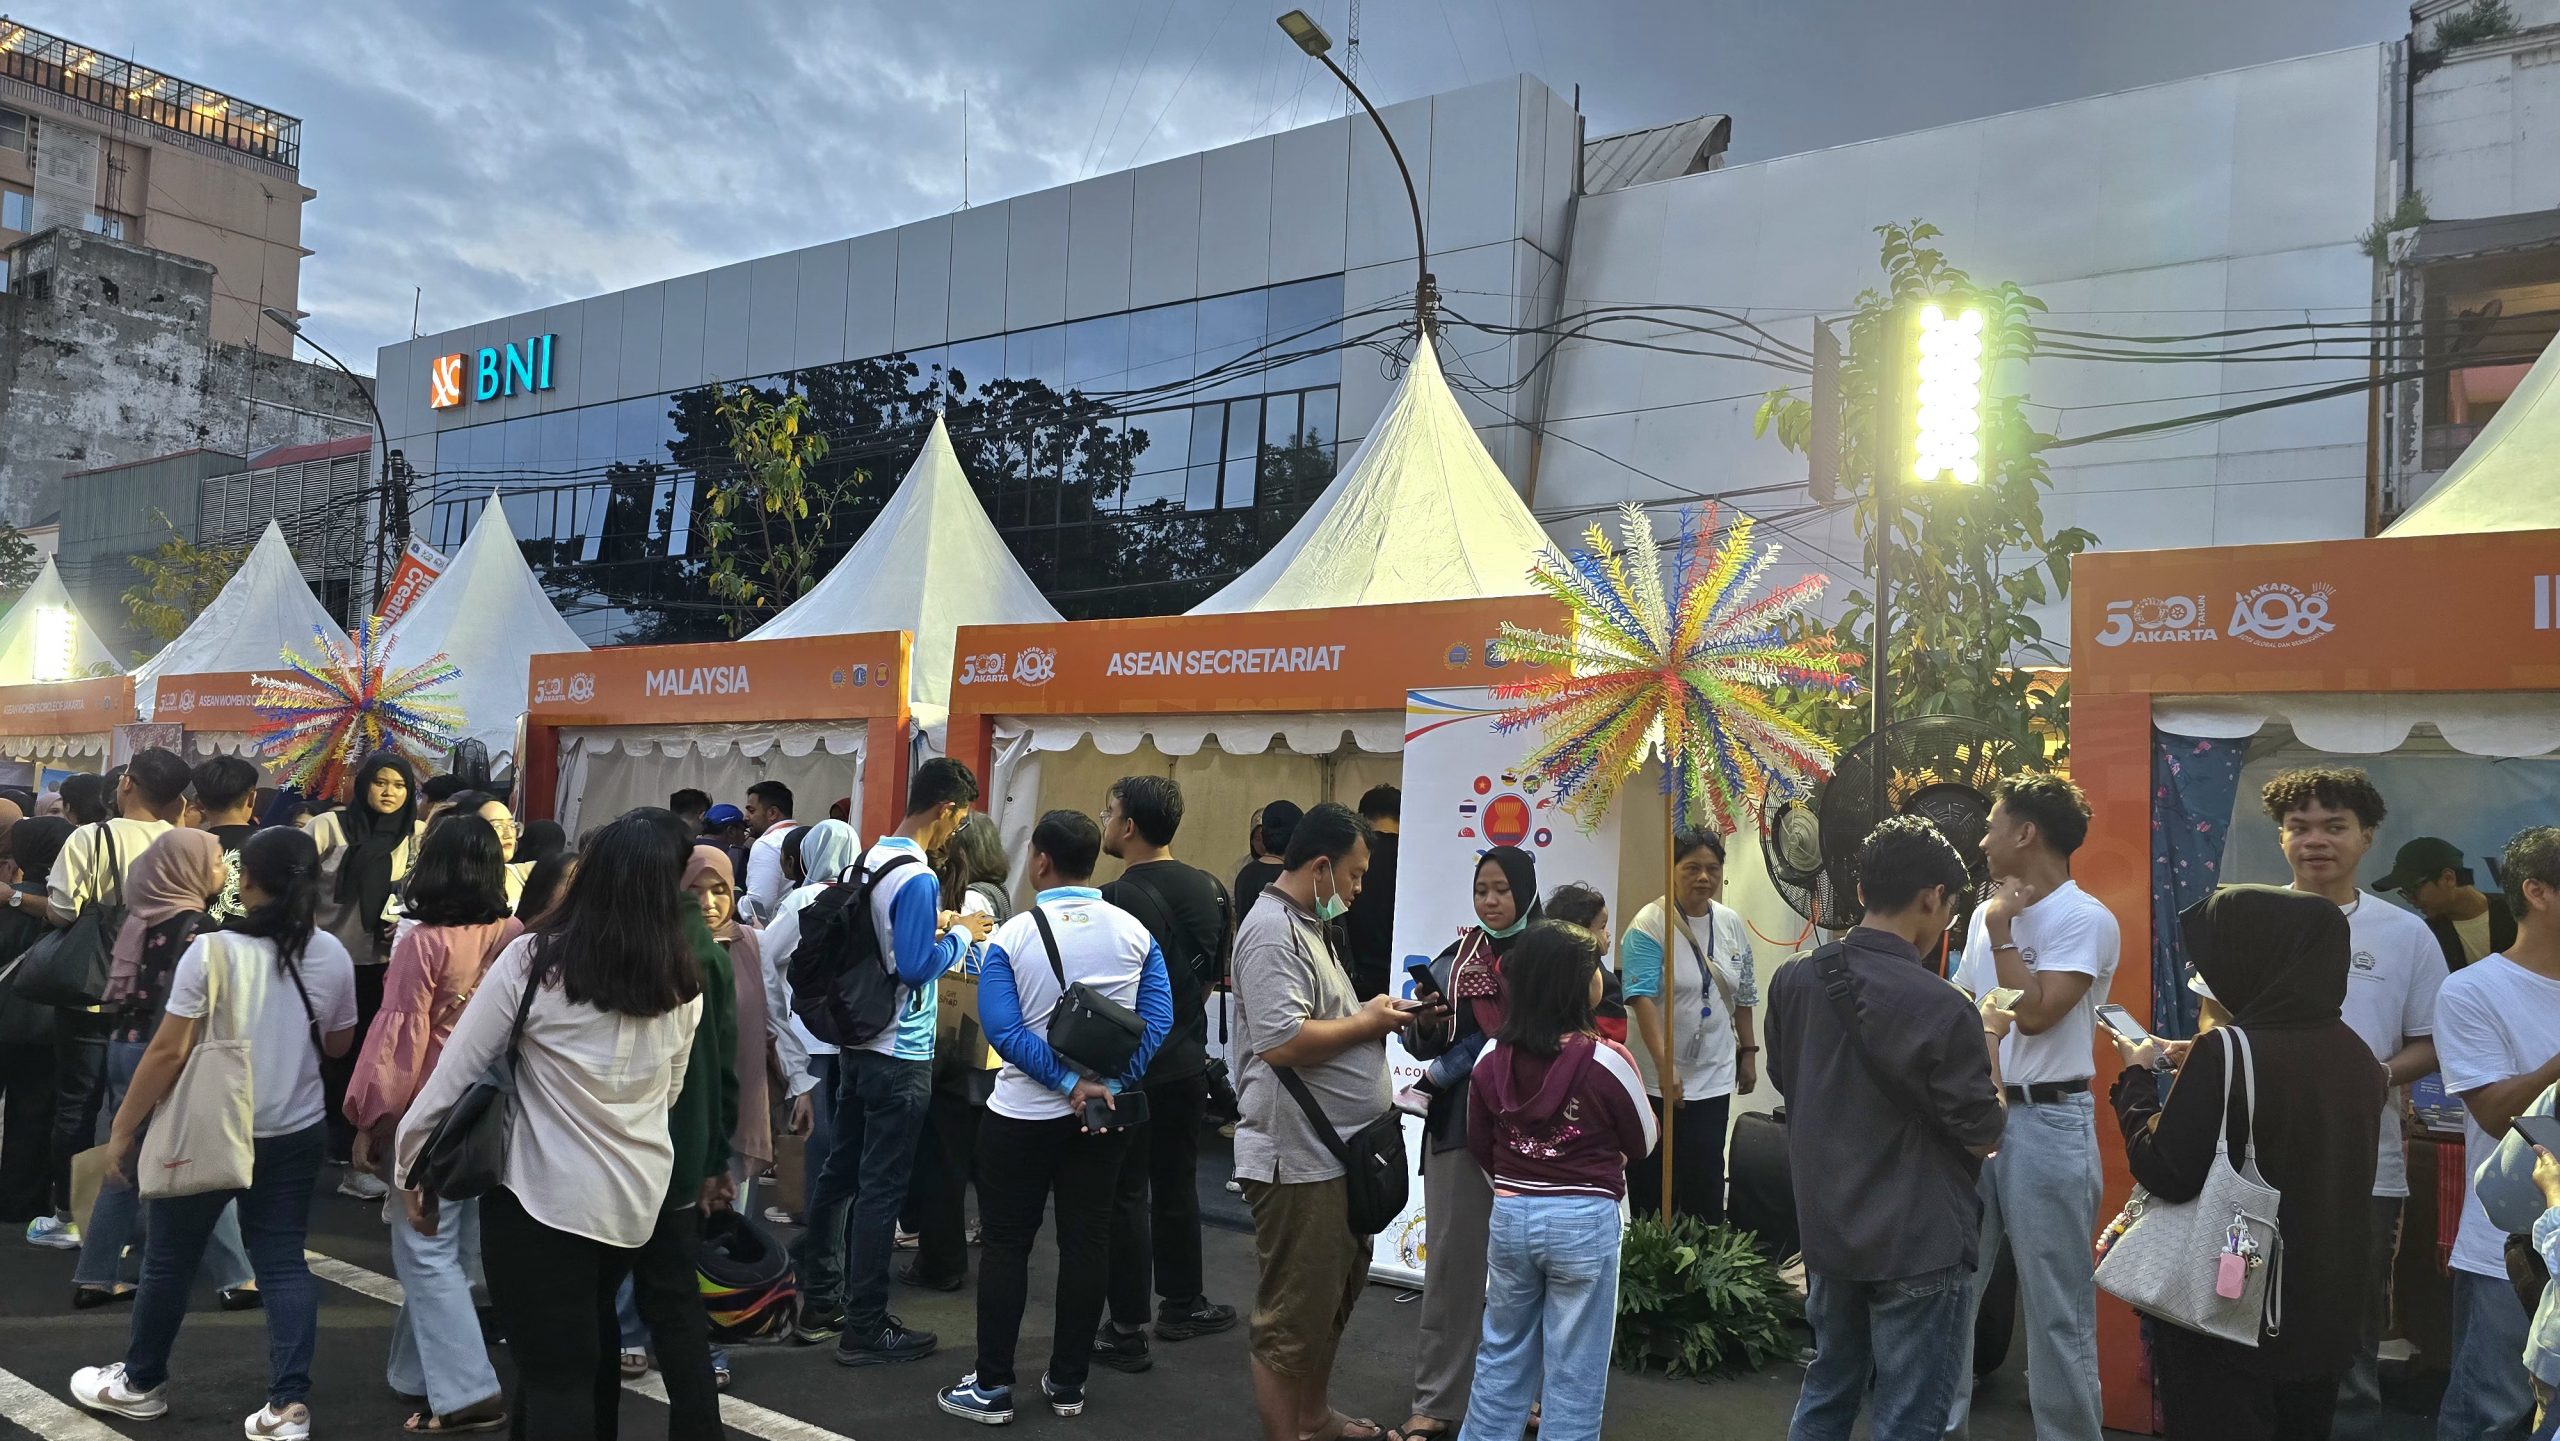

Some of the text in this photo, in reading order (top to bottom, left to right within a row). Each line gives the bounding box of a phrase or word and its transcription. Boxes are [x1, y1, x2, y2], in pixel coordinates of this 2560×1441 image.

[475, 334, 558, 402] BNI
[2243, 582, 2305, 603] JAKARTA
[2198, 595, 2206, 628] TAHUN
[1106, 645, 1345, 676] ASEAN SECRETARIAT
[645, 665, 750, 697] MALAYSIA
[199, 696, 220, 707] ASEAN
[220, 695, 249, 706] WOMEN'S
[1393, 1066, 1401, 1076] A
